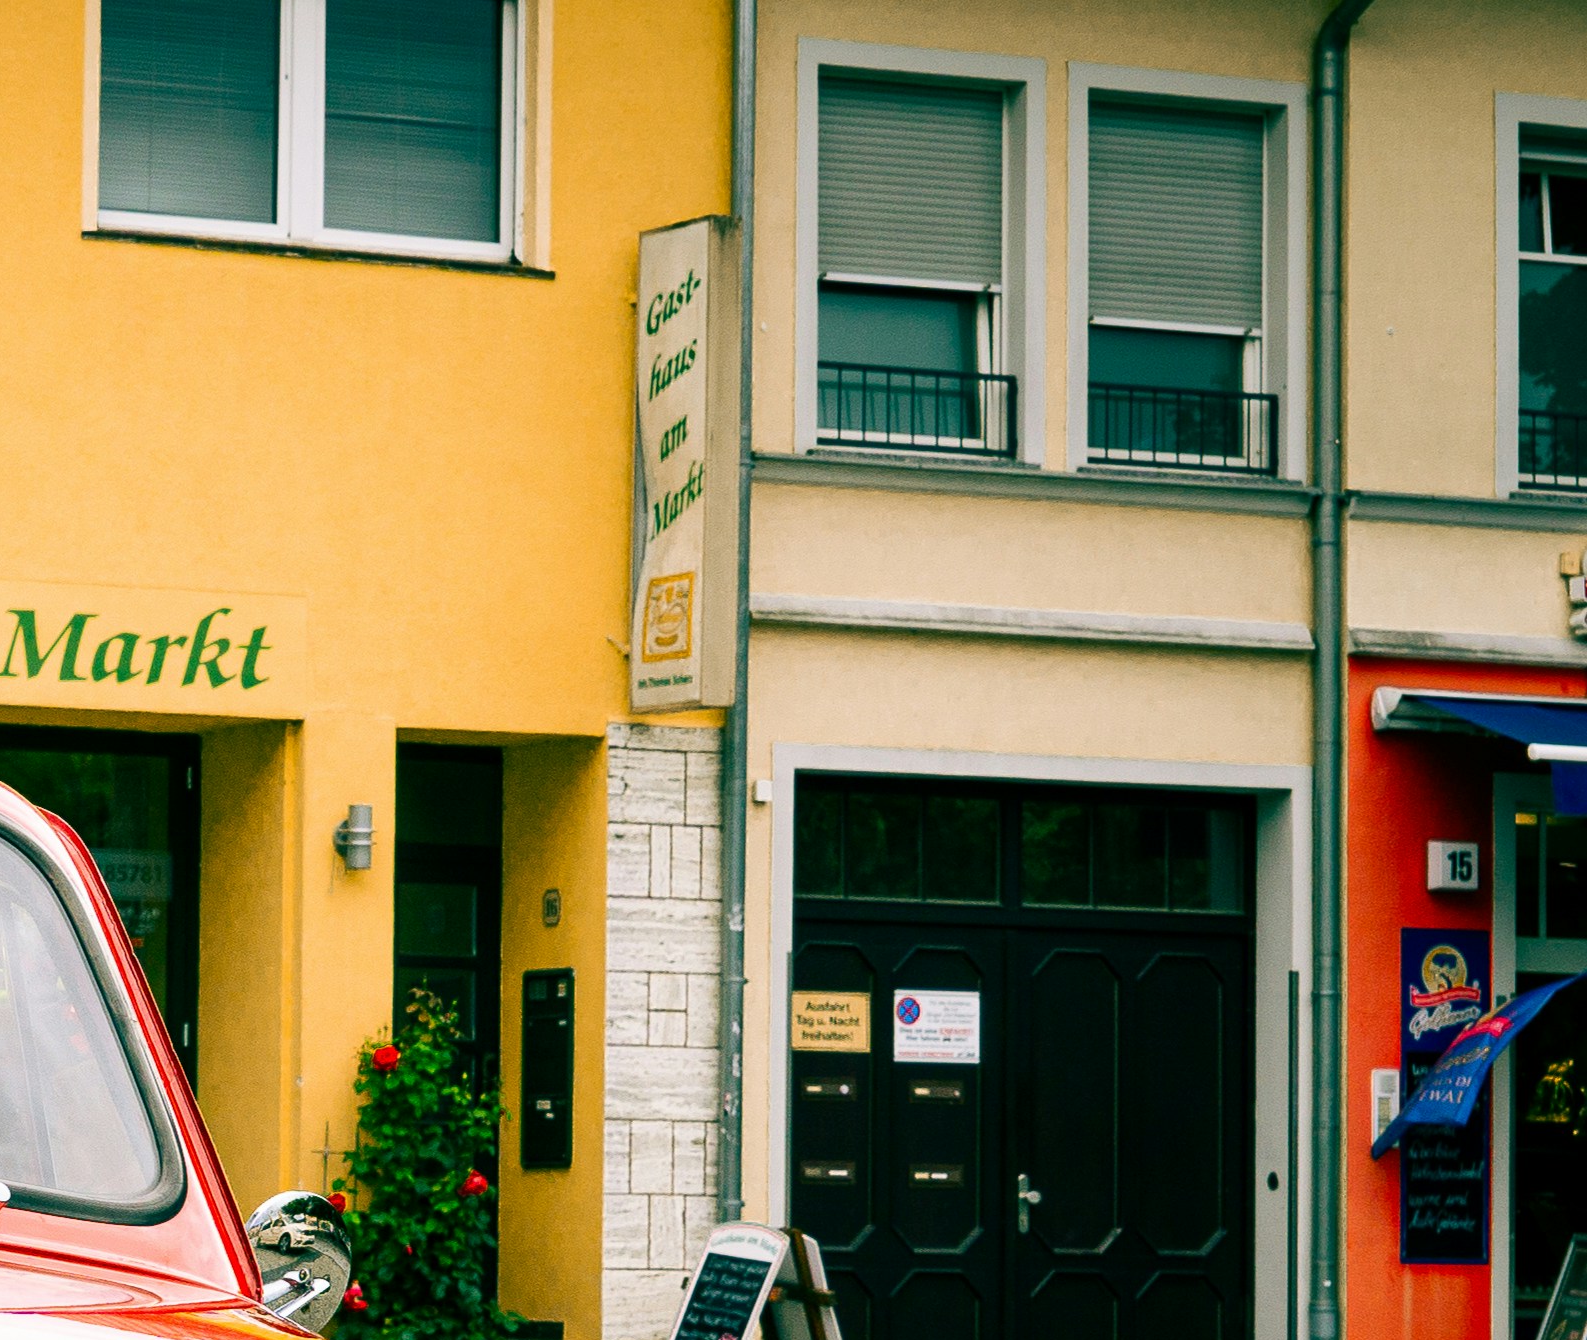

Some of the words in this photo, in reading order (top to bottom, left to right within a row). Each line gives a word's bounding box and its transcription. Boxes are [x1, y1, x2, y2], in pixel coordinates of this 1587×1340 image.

[648, 338, 698, 402] haus
[659, 413, 688, 463] am
[649, 460, 705, 543] Markt
[1446, 850, 1473, 883] 15
[805, 1001, 851, 1014] Ausfahrt
[828, 1016, 861, 1027] Nacht
